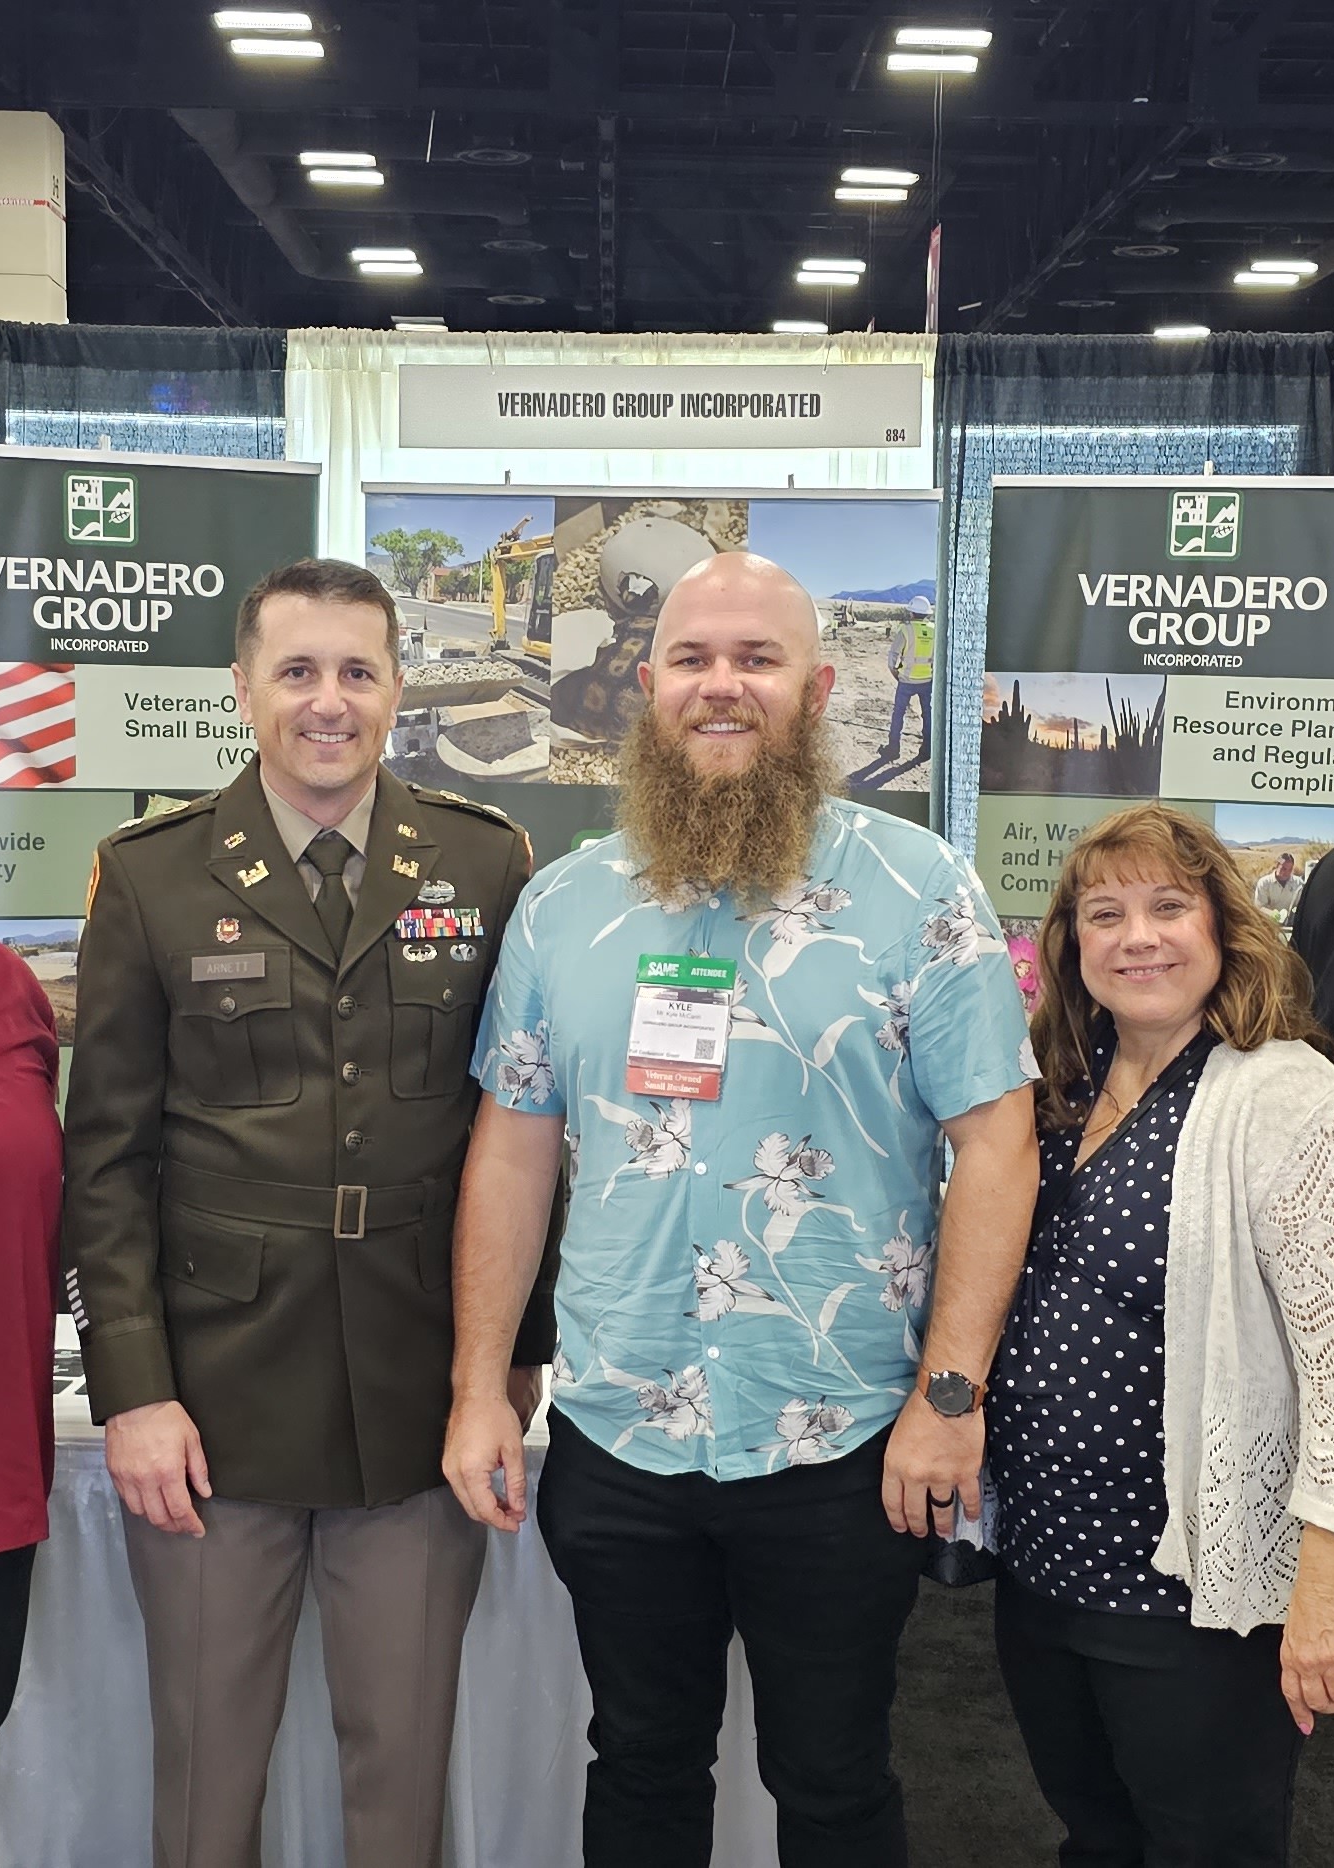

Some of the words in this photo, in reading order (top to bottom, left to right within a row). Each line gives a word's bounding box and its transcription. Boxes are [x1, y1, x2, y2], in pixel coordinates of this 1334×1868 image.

[498, 393, 606, 417] VERNADERO
[612, 393, 674, 418] GROUP
[681, 393, 820, 418] INCORPORATED
[885, 429, 906, 442] 884
[1077, 574, 1328, 611] VERNADERO
[33, 596, 173, 633] GROUP
[1129, 612, 1271, 648] GROUP
[50, 639, 148, 653] INCORPORATED
[1143, 654, 1242, 668] INCORPORATED
[125, 720, 187, 738] Small
[1173, 716, 1283, 738] Resource
[1212, 745, 1256, 763] and
[1003, 823, 1037, 844] Air,
[1002, 849, 1039, 866] and
[207, 962, 248, 974] ARNETT
[648, 962, 679, 977] SAME
[691, 968, 726, 978] ATTENDEE
[669, 1003, 692, 1011] KYLE
[645, 1070, 673, 1081] Veteran
[675, 1074, 701, 1083] Owned
[644, 1081, 665, 1091] Small
[667, 1084, 699, 1093] Business
